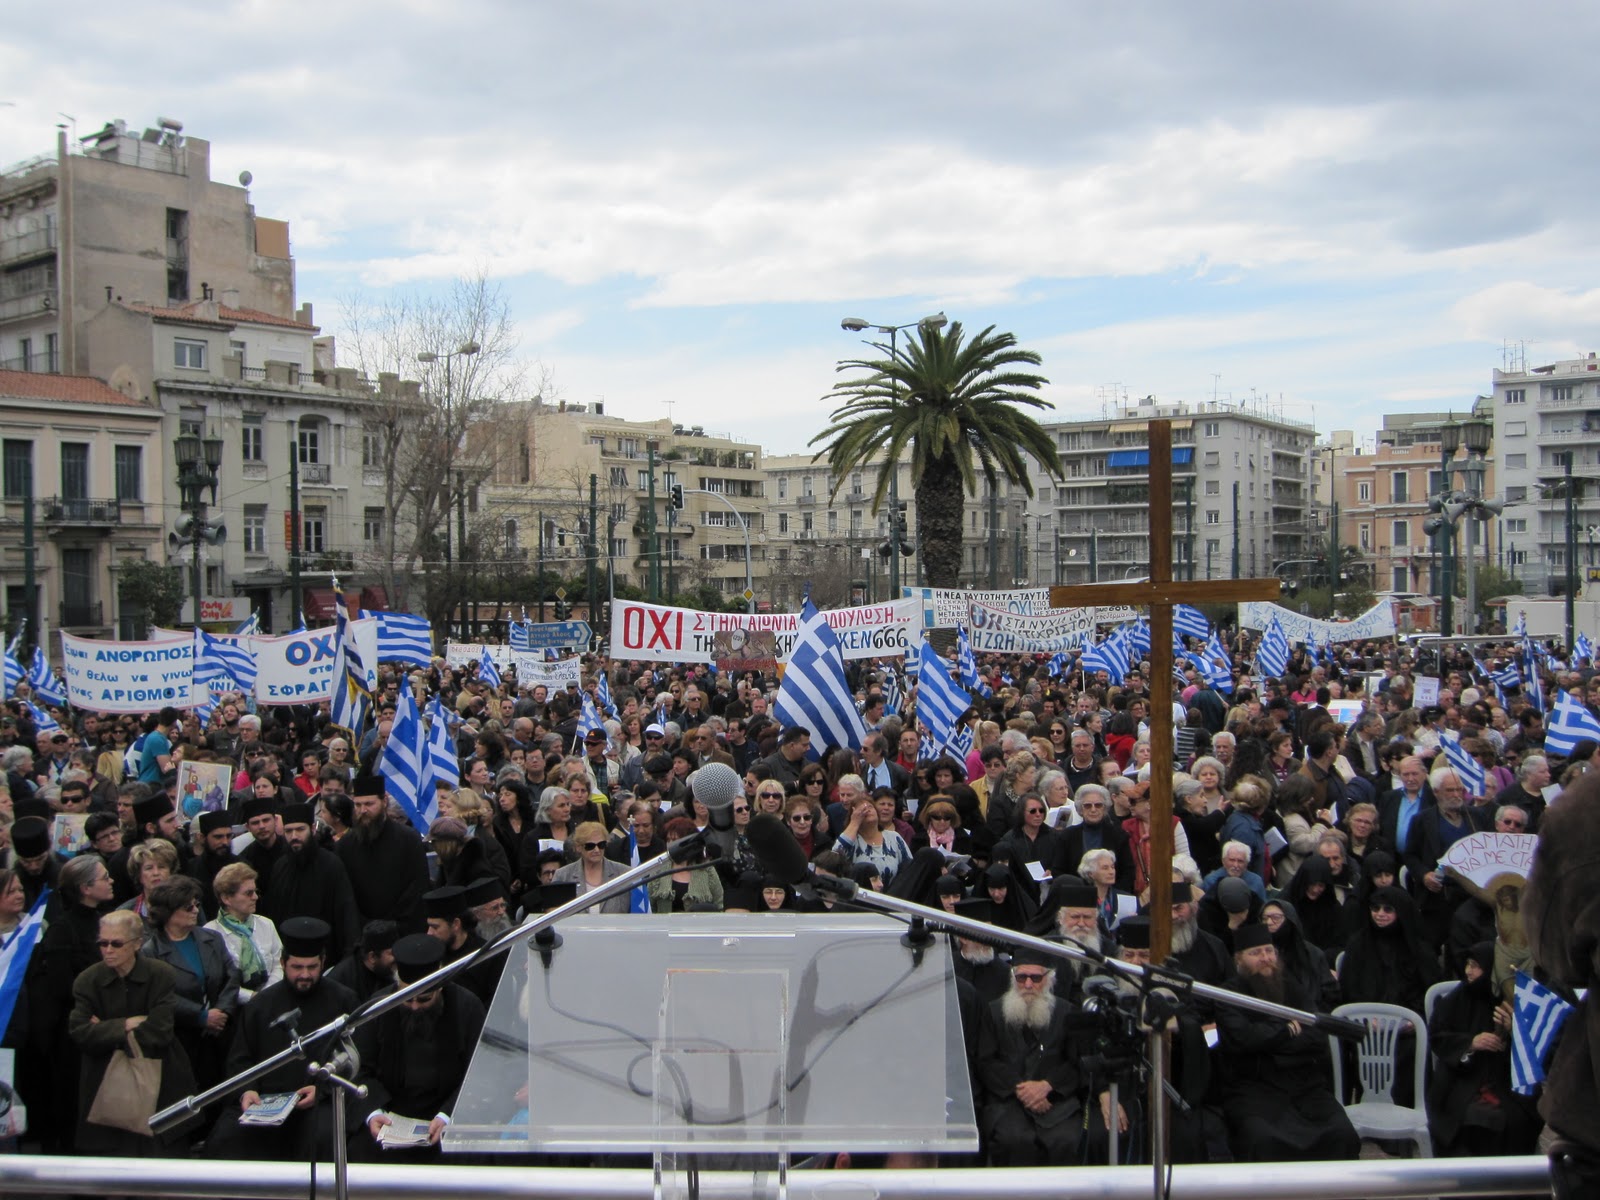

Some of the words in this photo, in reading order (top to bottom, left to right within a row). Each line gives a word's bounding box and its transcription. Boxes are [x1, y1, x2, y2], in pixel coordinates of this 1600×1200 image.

[944, 591, 960, 599] ΝΕΑ
[200, 601, 222, 610] Tasty
[1008, 601, 1032, 617] ΟΧΙ
[200, 610, 219, 619] City
[623, 606, 684, 650] ΟΧΙ
[693, 613, 742, 631] ΣΤΗΝ
[748, 615, 797, 631] ΑΙΩΝΙΑ
[873, 626, 907, 649] 666
[972, 631, 982, 648] Η
[984, 632, 1015, 651] ΖΩΗ
[95, 646, 192, 663] ΑΝΘΡΩΠΟΣ
[285, 633, 338, 667] ΟΧ
[87, 670, 119, 682] θελω
[131, 674, 149, 682] να
[161, 669, 193, 683] γινω
[70, 686, 92, 700] ενας
[101, 685, 189, 701] ΑΡΙΘΜΟΣ
